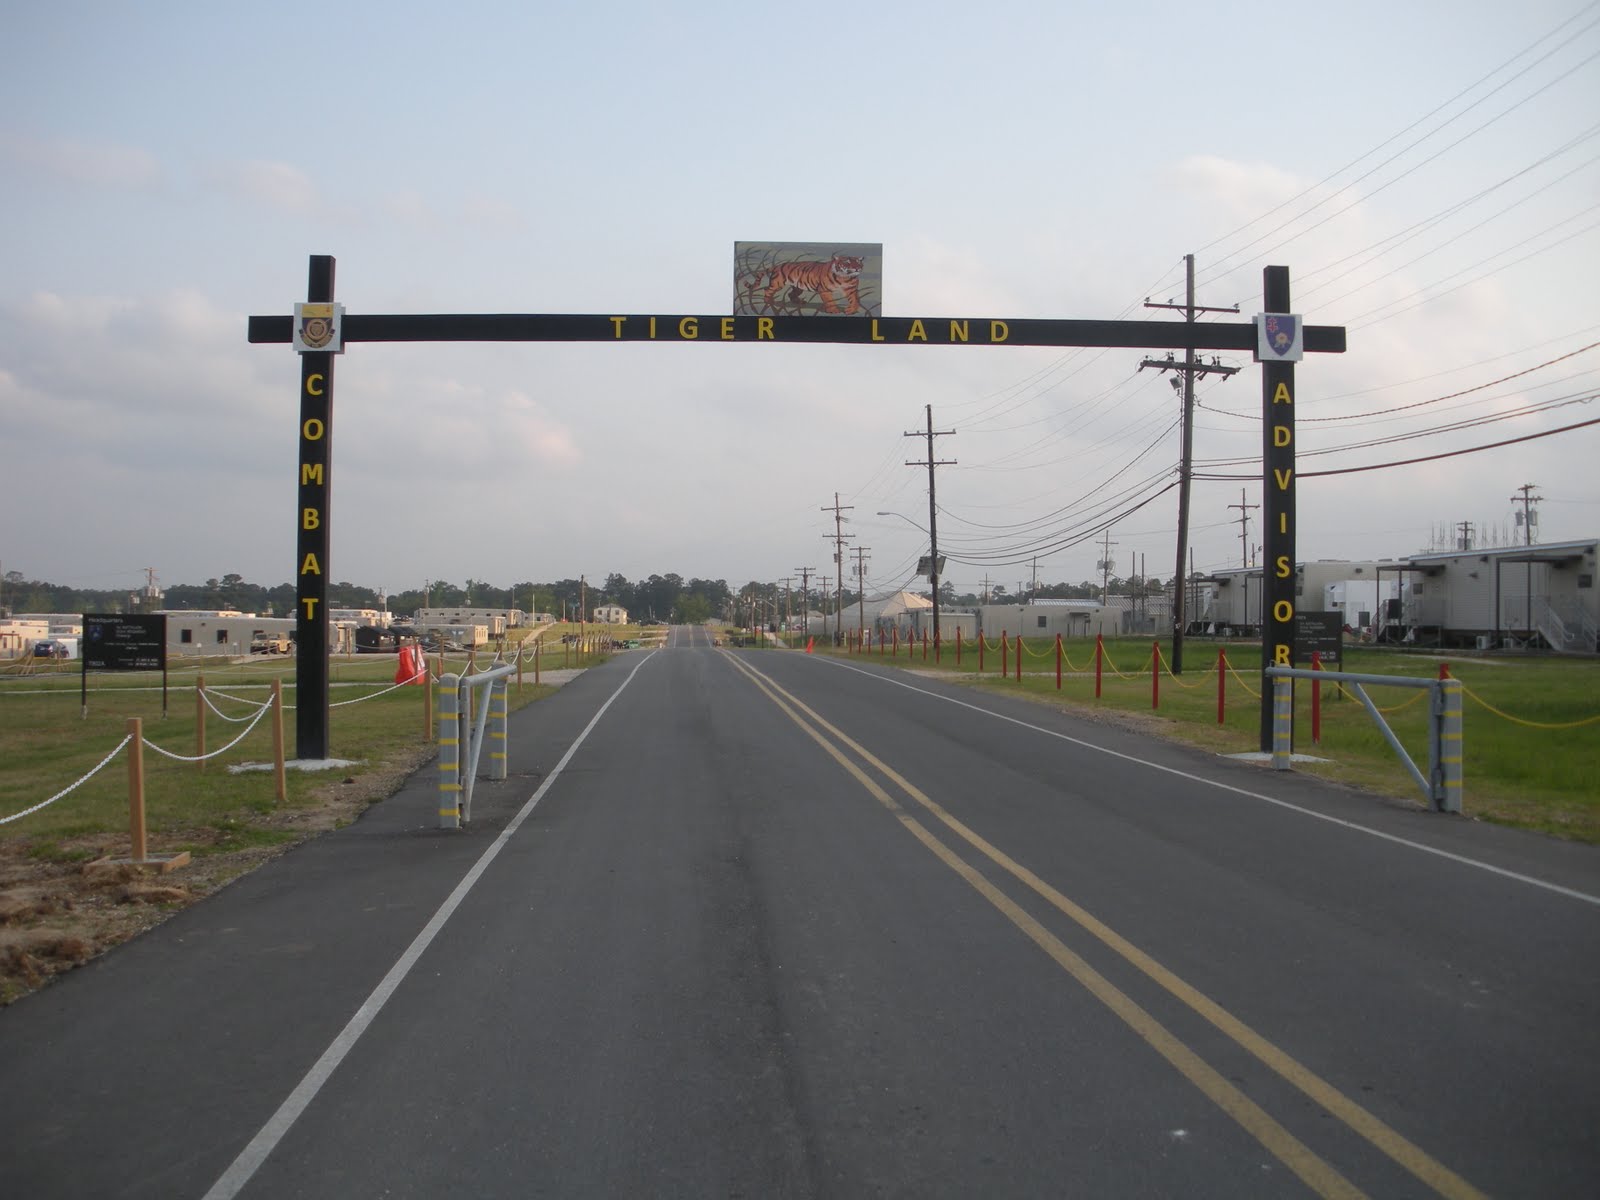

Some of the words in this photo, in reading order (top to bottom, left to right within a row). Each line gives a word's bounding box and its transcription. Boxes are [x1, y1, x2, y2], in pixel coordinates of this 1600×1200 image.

[609, 317, 776, 341] TIGER
[871, 319, 1009, 344] LAND
[301, 373, 325, 622] COMBAT
[1272, 382, 1294, 667] ADVISOR
